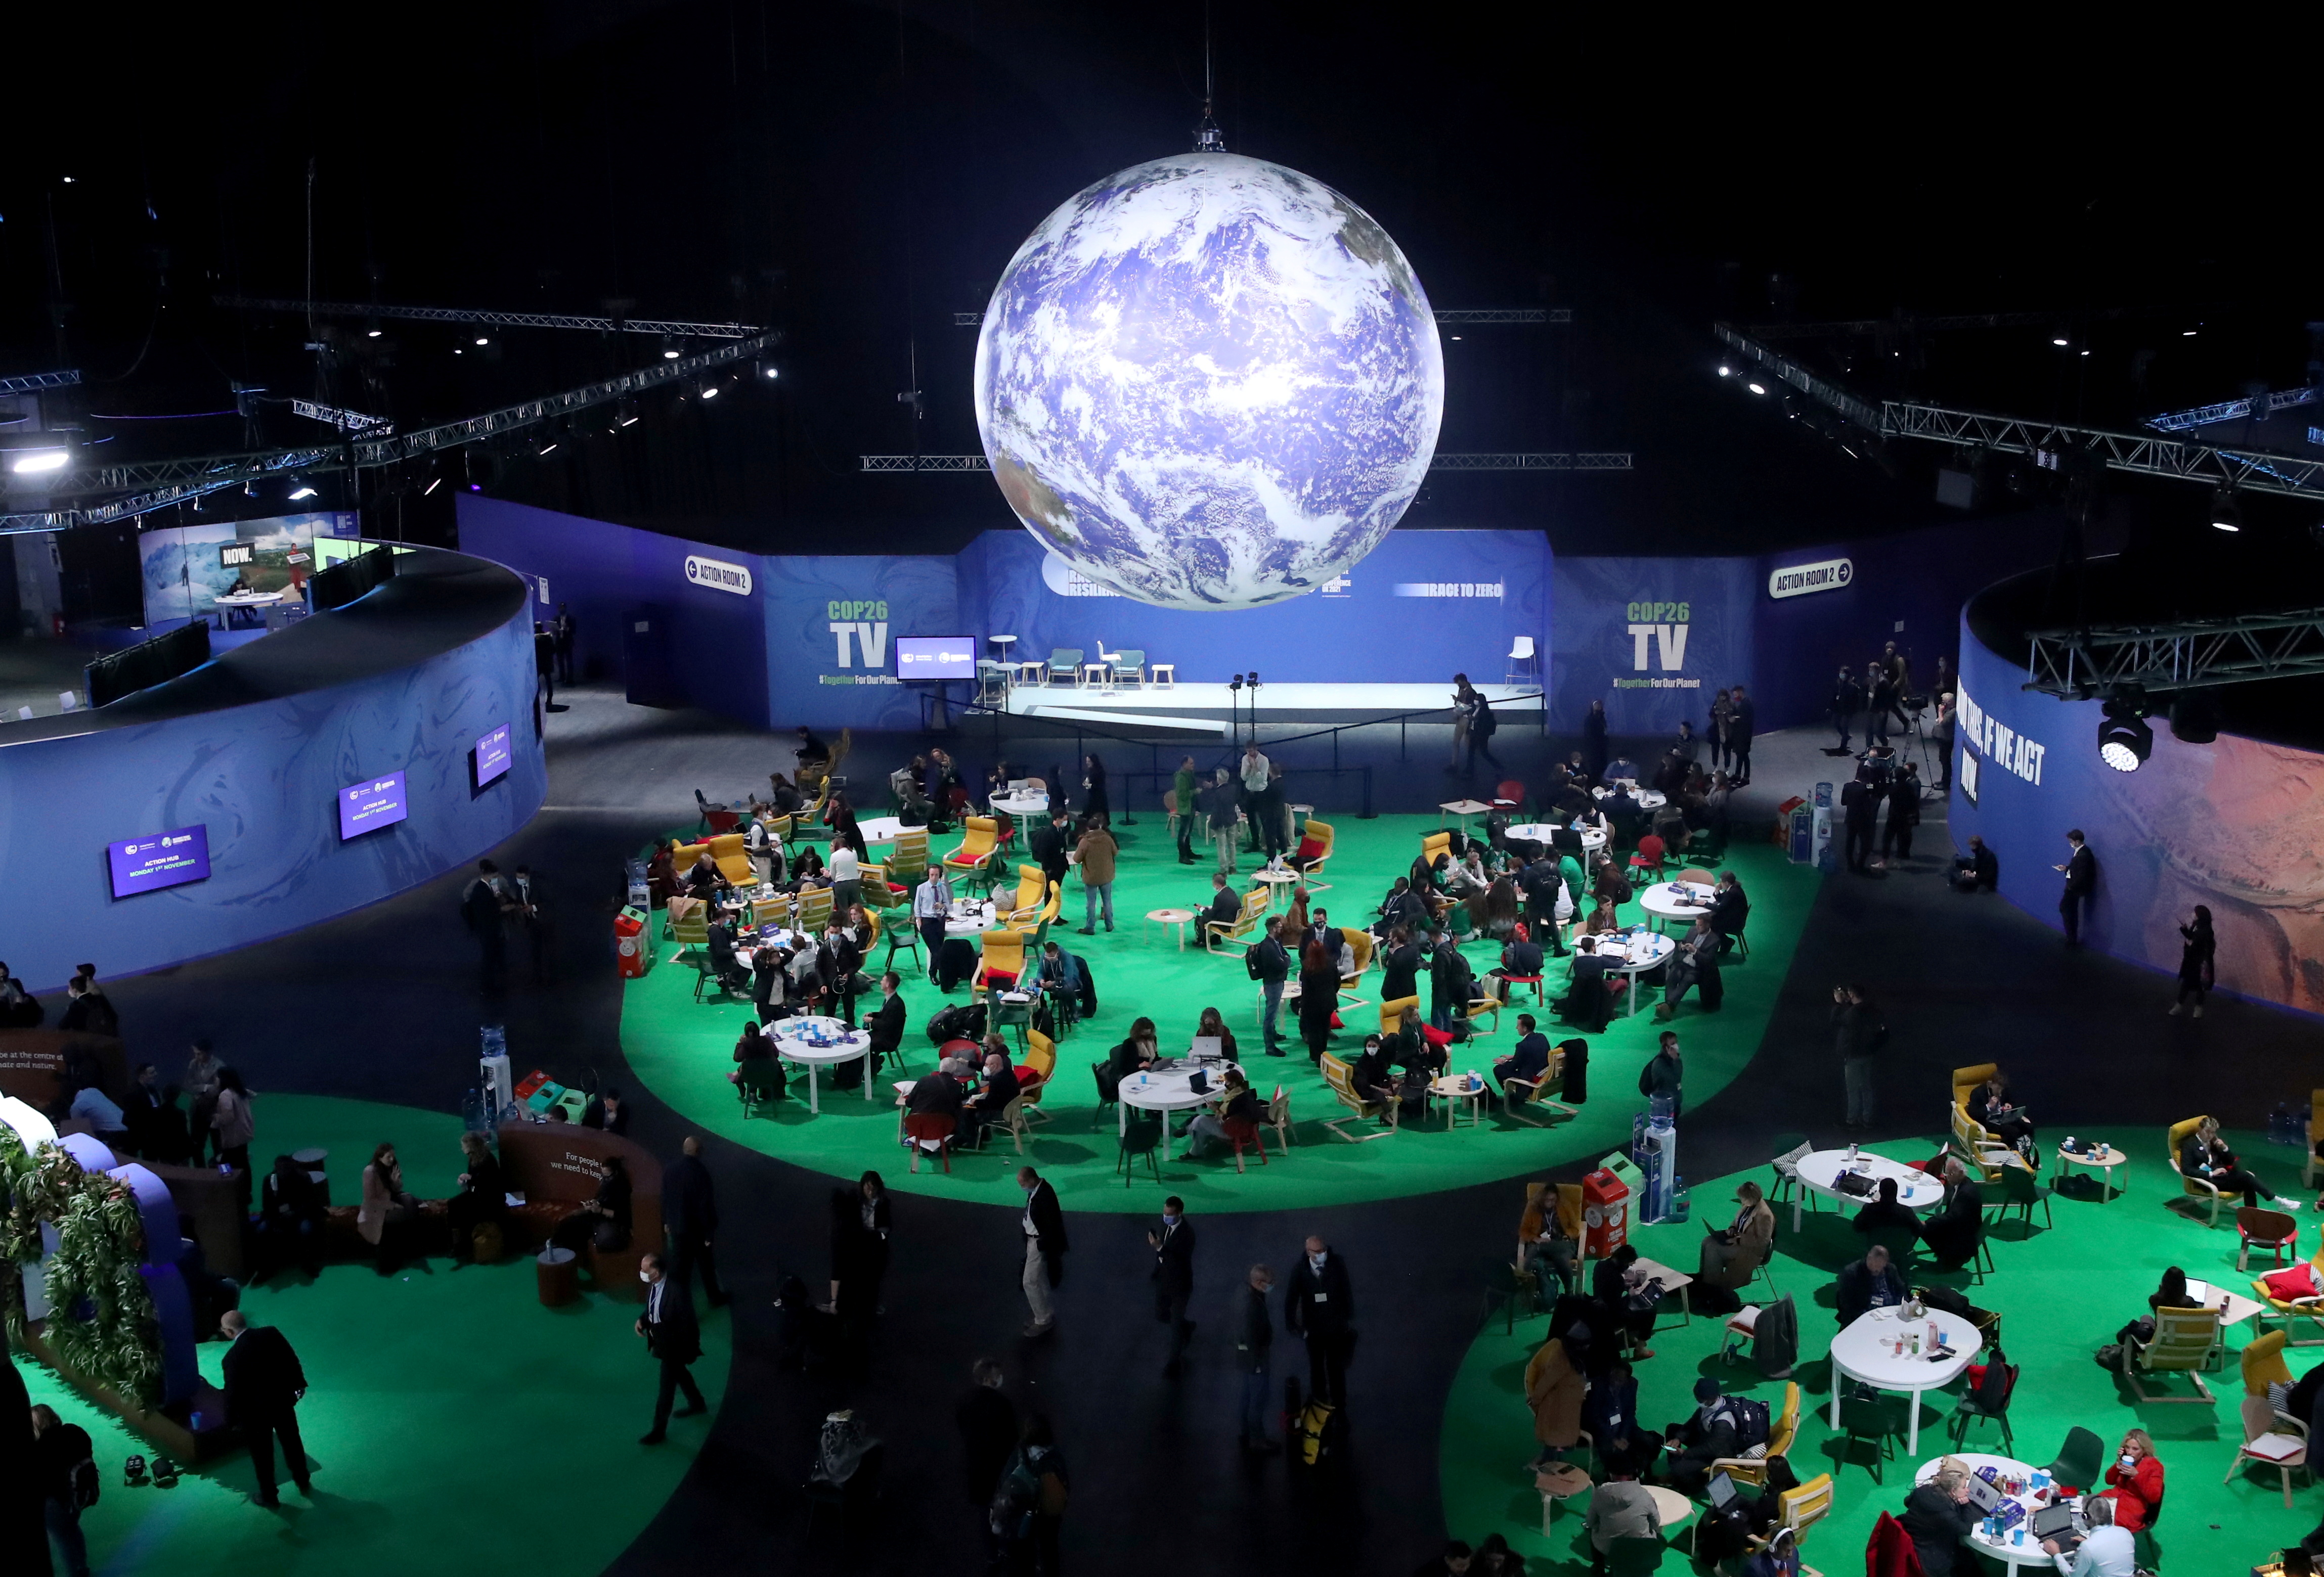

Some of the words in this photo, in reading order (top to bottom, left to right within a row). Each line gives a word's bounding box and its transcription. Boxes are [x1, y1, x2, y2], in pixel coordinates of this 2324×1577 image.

[223, 547, 252, 565] NOW.
[700, 565, 722, 583] ACTION
[723, 569, 740, 588] ROOM
[741, 574, 746, 589] 2
[1777, 572, 1805, 592] ACTION
[1806, 568, 1828, 587] ROOM
[1829, 567, 1834, 582] 2
[1429, 583, 1459, 597] RACE
[1461, 583, 1474, 597] TO
[1475, 583, 1503, 597] ZERO
[828, 600, 888, 620] COP26
[1627, 602, 1690, 622] COP26
[829, 622, 888, 668] TV
[1628, 624, 1688, 670] TV
[1613, 678, 1700, 689] #TogetherForOurPlanet
[1984, 714, 1994, 756] IF
[1995, 722, 2013, 771] WE
[2013, 735, 2045, 786] ACT
[1961, 747, 1977, 801] NOW.
[129, 867, 154, 877] MONDAY
[164, 859, 195, 870] NOVEMBER
[145, 857, 166, 867] ACTION
[566, 1152, 578, 1161] For
[579, 1156, 599, 1167] people
[563, 1164, 581, 1173] need
[590, 1168, 602, 1181] keep
